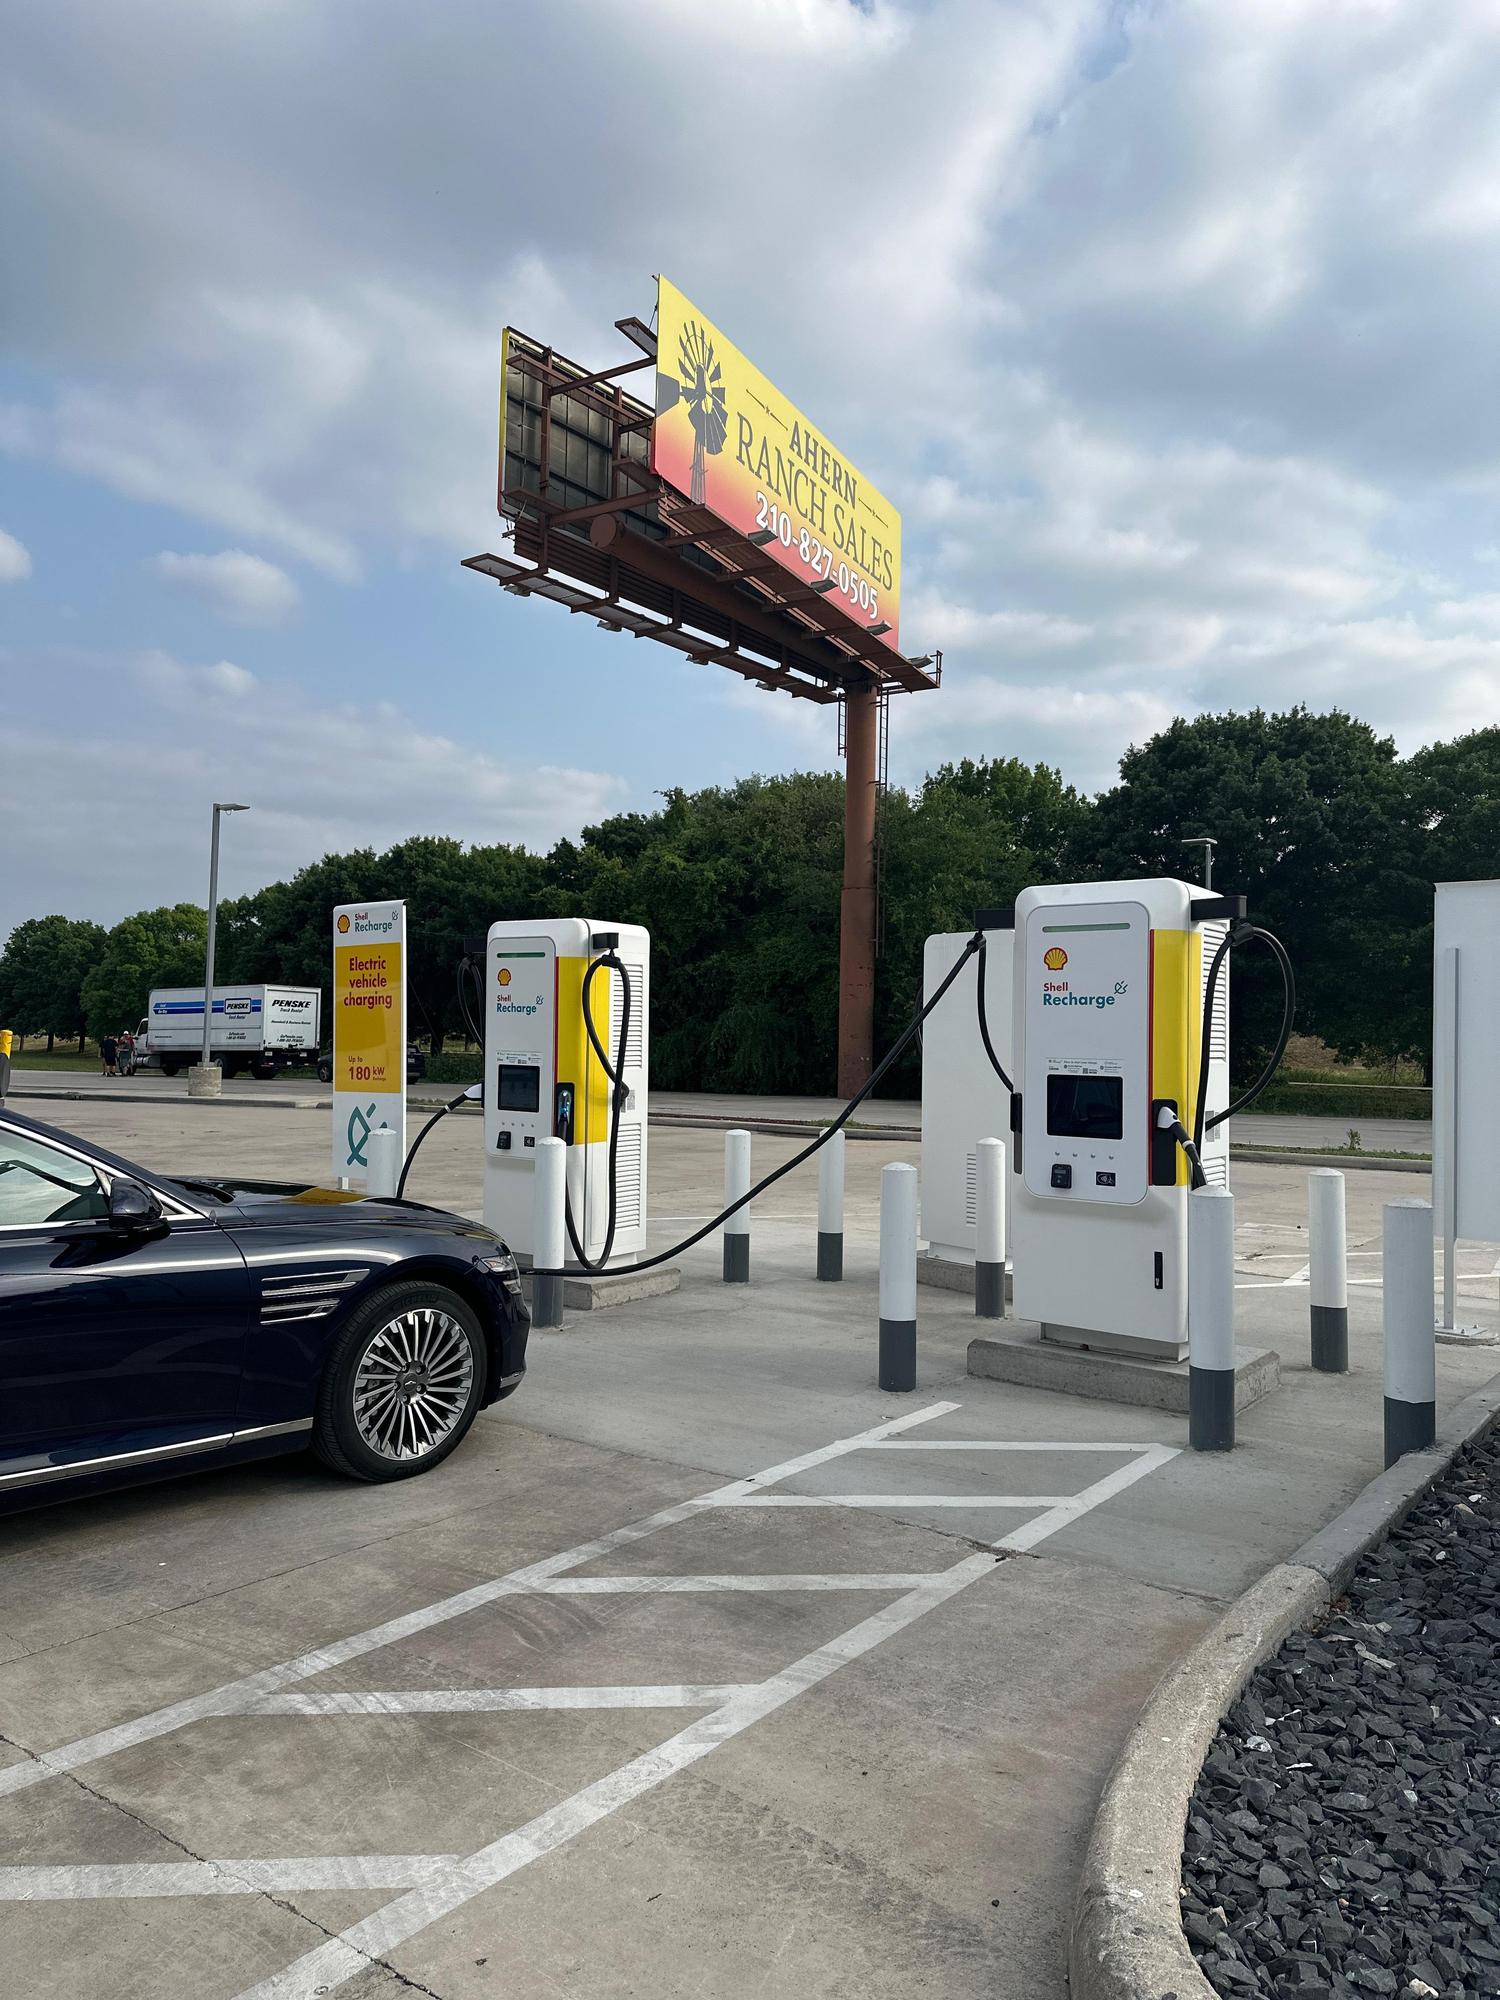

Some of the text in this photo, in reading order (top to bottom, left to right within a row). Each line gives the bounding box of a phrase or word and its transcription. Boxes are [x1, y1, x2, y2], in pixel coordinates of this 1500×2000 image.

[789, 420, 857, 510] AHERN
[736, 411, 893, 591] RANCH SALES
[755, 490, 879, 619] 210-827-0505
[354, 912, 369, 921] Shell
[354, 920, 393, 933] Recharge
[349, 955, 387, 972] Electric
[349, 972, 388, 989] vehicle
[1043, 981, 1069, 992] Shell
[271, 999, 312, 1009] PENSKE
[343, 990, 393, 1010] charging
[496, 994, 512, 1002] Shell
[1043, 991, 1116, 1009] Recharge
[227, 1002, 249, 1010] PENSKE
[496, 1001, 537, 1016] Recharge
[348, 1055, 364, 1064] Up to
[348, 1066, 371, 1081] 180
[372, 1066, 385, 1076] kW
